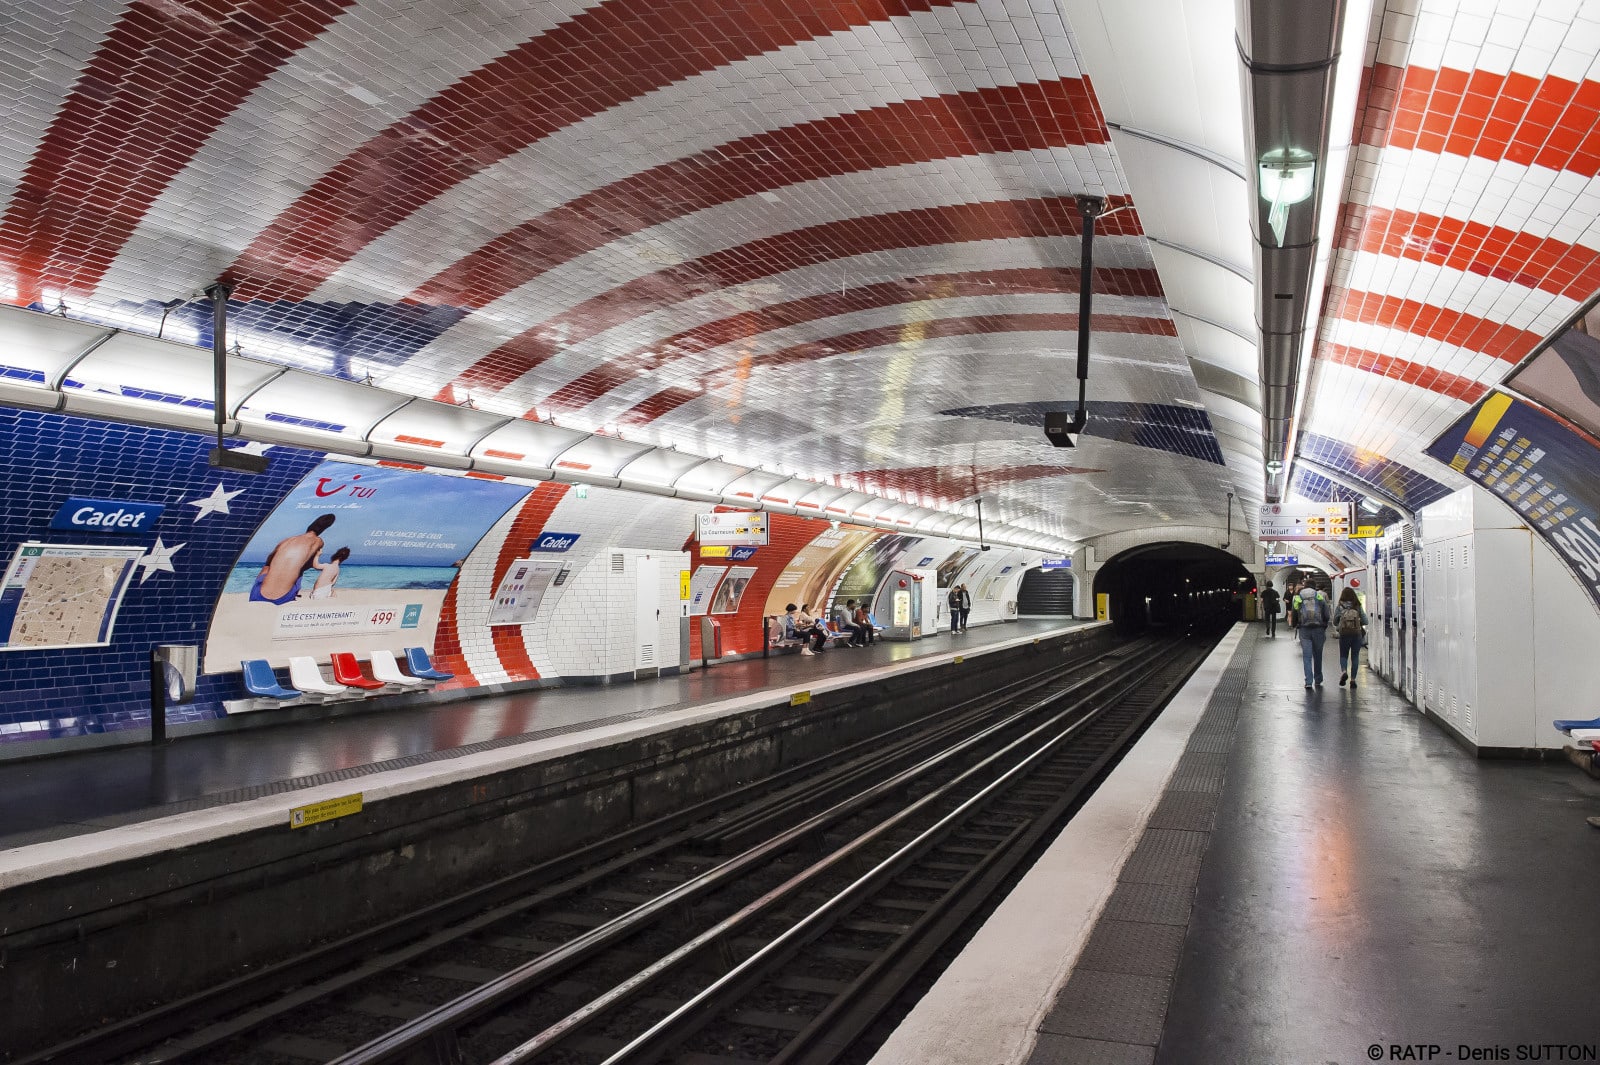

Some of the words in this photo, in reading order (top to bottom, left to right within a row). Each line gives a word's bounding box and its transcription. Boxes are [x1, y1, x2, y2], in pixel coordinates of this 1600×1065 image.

[349, 486, 378, 498] TUI
[71, 506, 146, 528] Cadet
[541, 536, 572, 548] Cadet
